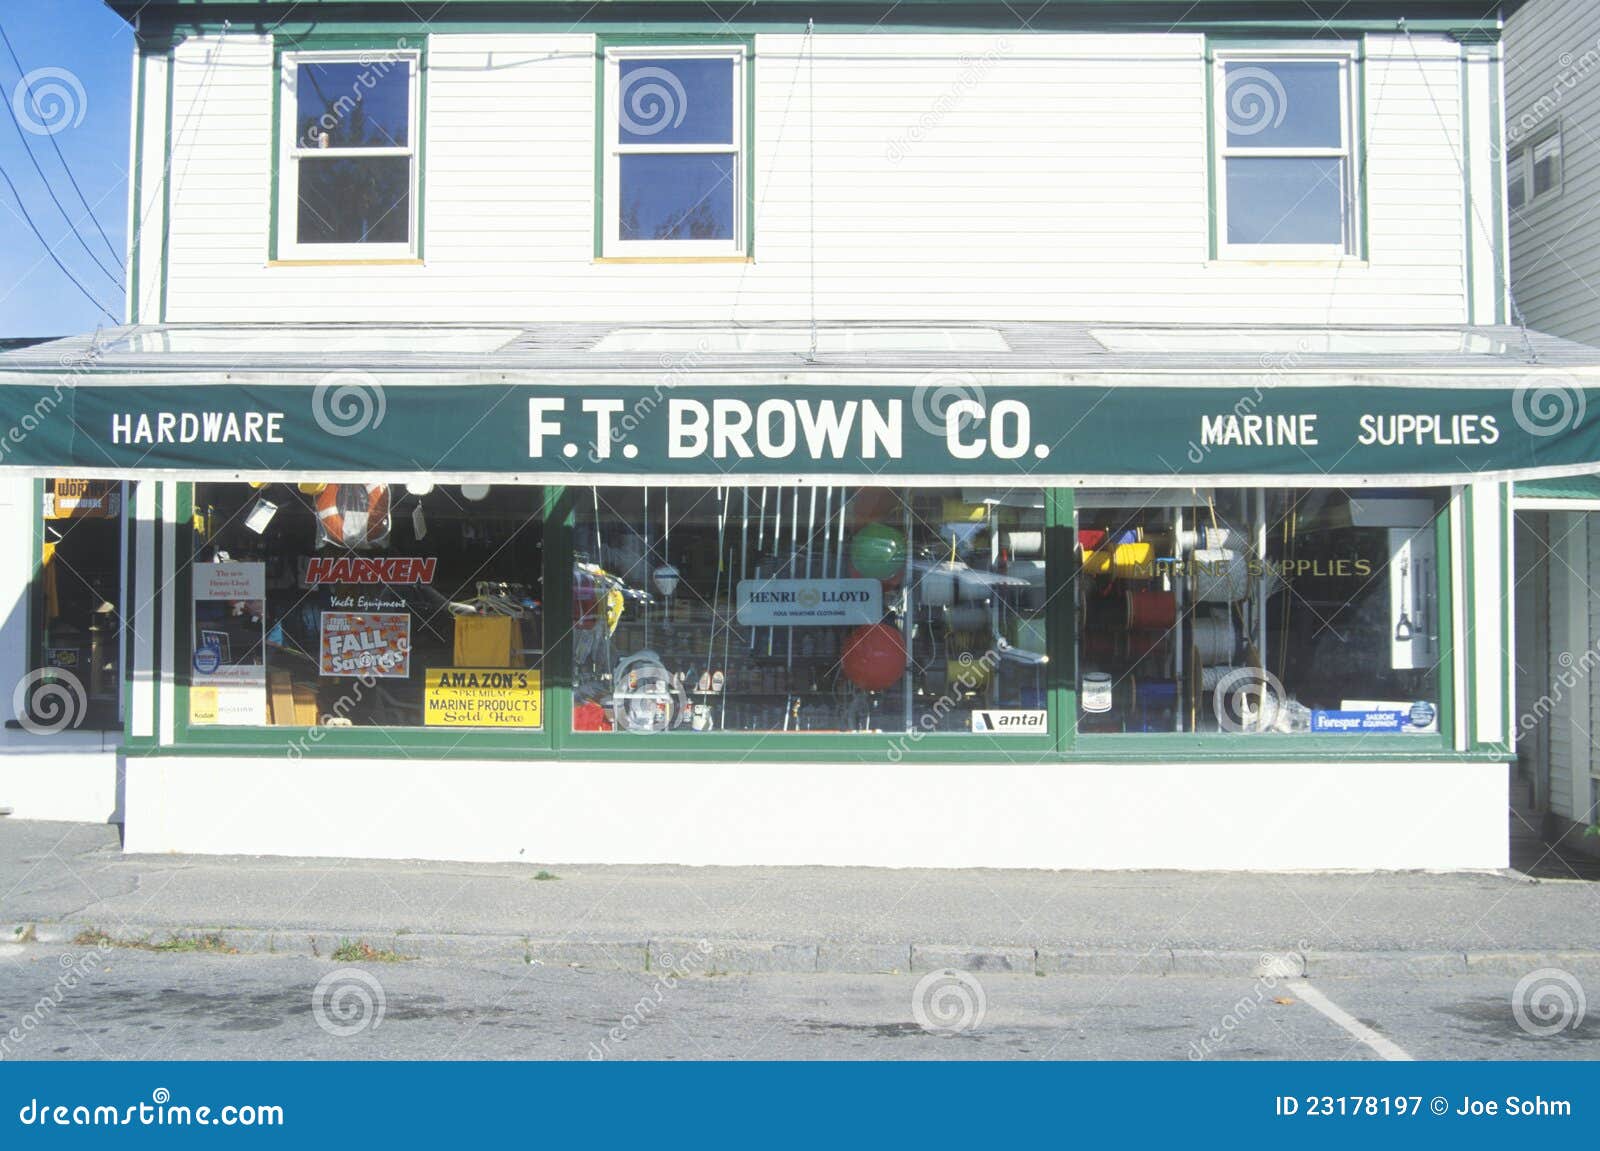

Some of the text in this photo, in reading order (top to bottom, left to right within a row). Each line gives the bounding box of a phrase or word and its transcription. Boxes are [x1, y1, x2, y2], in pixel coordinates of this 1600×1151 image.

[112, 412, 284, 444] HARDWARE
[528, 397, 1050, 460] F.T. BROWN CO.
[1201, 414, 1499, 446] MARINE SUPPLIES
[305, 557, 437, 584] HARKEN
[1133, 559, 1372, 577] MARINE SUPPLIES
[330, 595, 406, 610] Yacht Equipment
[750, 591, 870, 602] HENRI LLOYD
[328, 630, 388, 655] FALL
[438, 672, 528, 688] AMAZON'S
[429, 699, 538, 711] MARINE PRODUCTS
[443, 711, 524, 722] Sold Here
[999, 713, 1045, 726] antal
